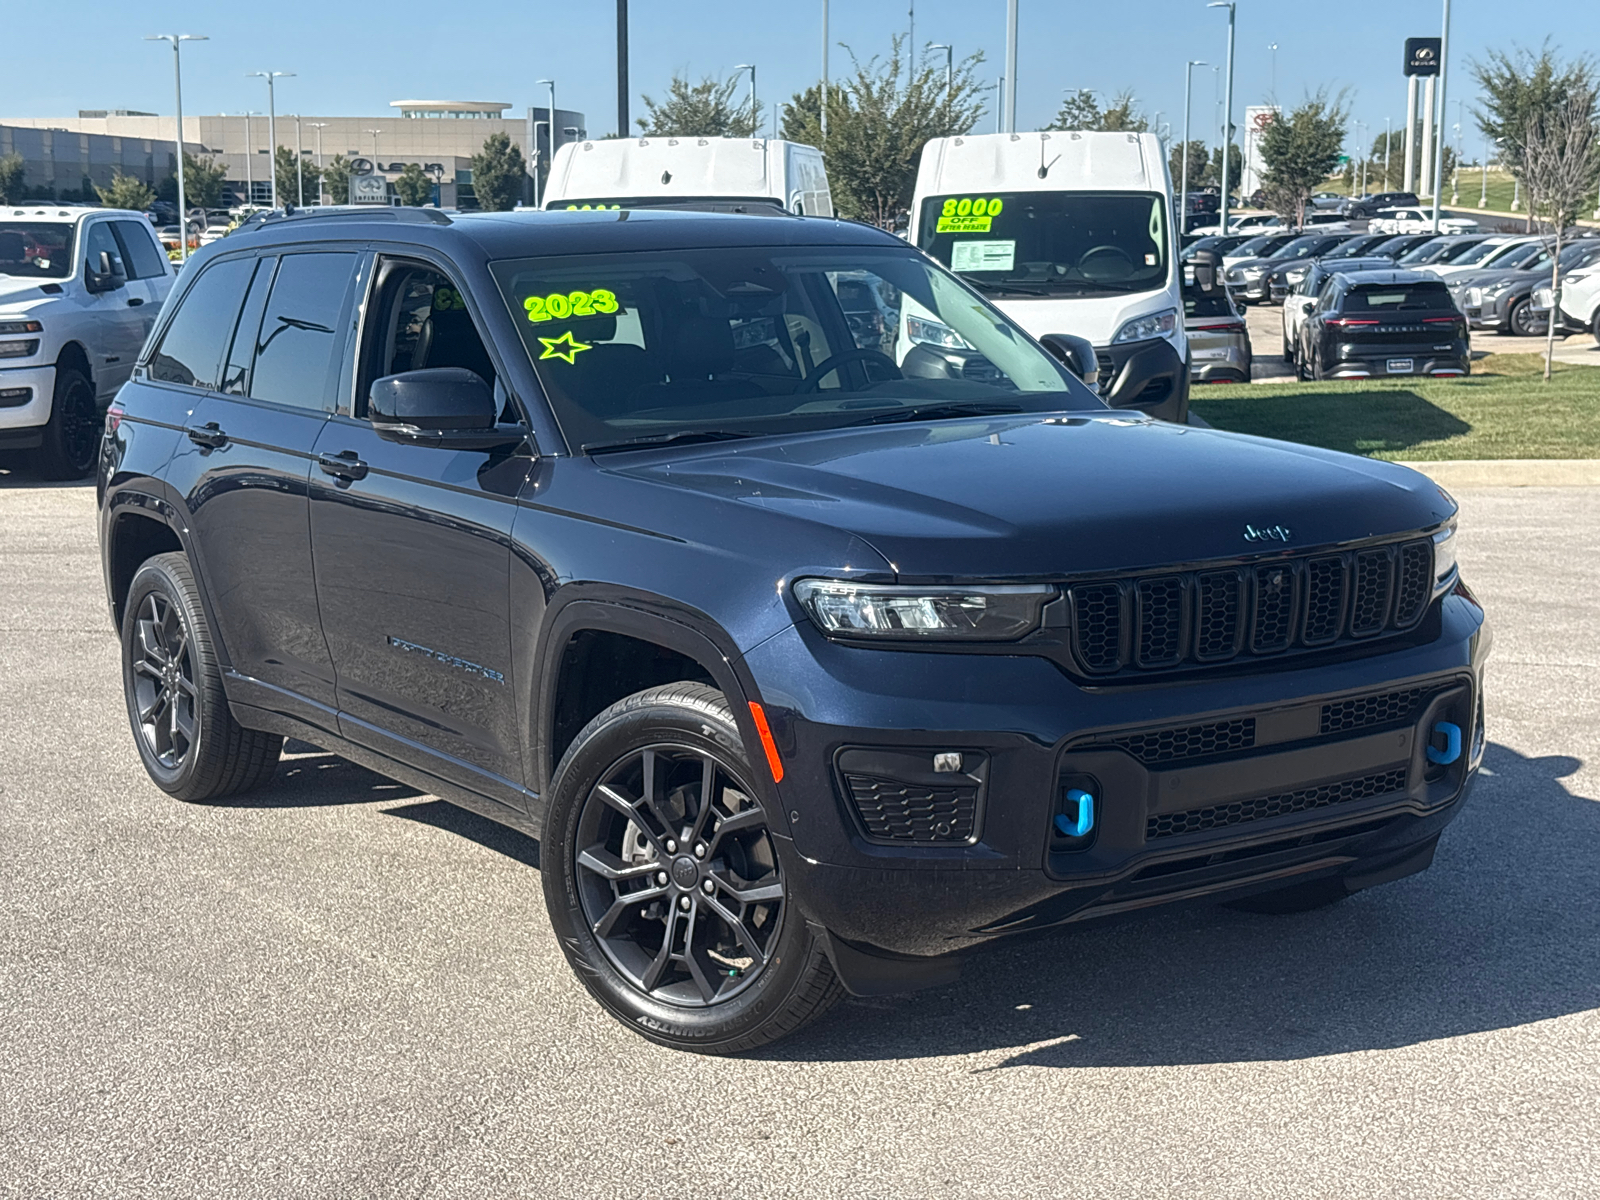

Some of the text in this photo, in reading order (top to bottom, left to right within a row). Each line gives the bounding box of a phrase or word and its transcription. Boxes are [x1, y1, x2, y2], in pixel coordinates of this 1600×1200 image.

[942, 198, 1003, 217] 8000
[524, 289, 619, 322] 2023
[1243, 524, 1292, 542] Jeep
[701, 724, 751, 768] TOY
[635, 1014, 719, 1038] COUNTRY
